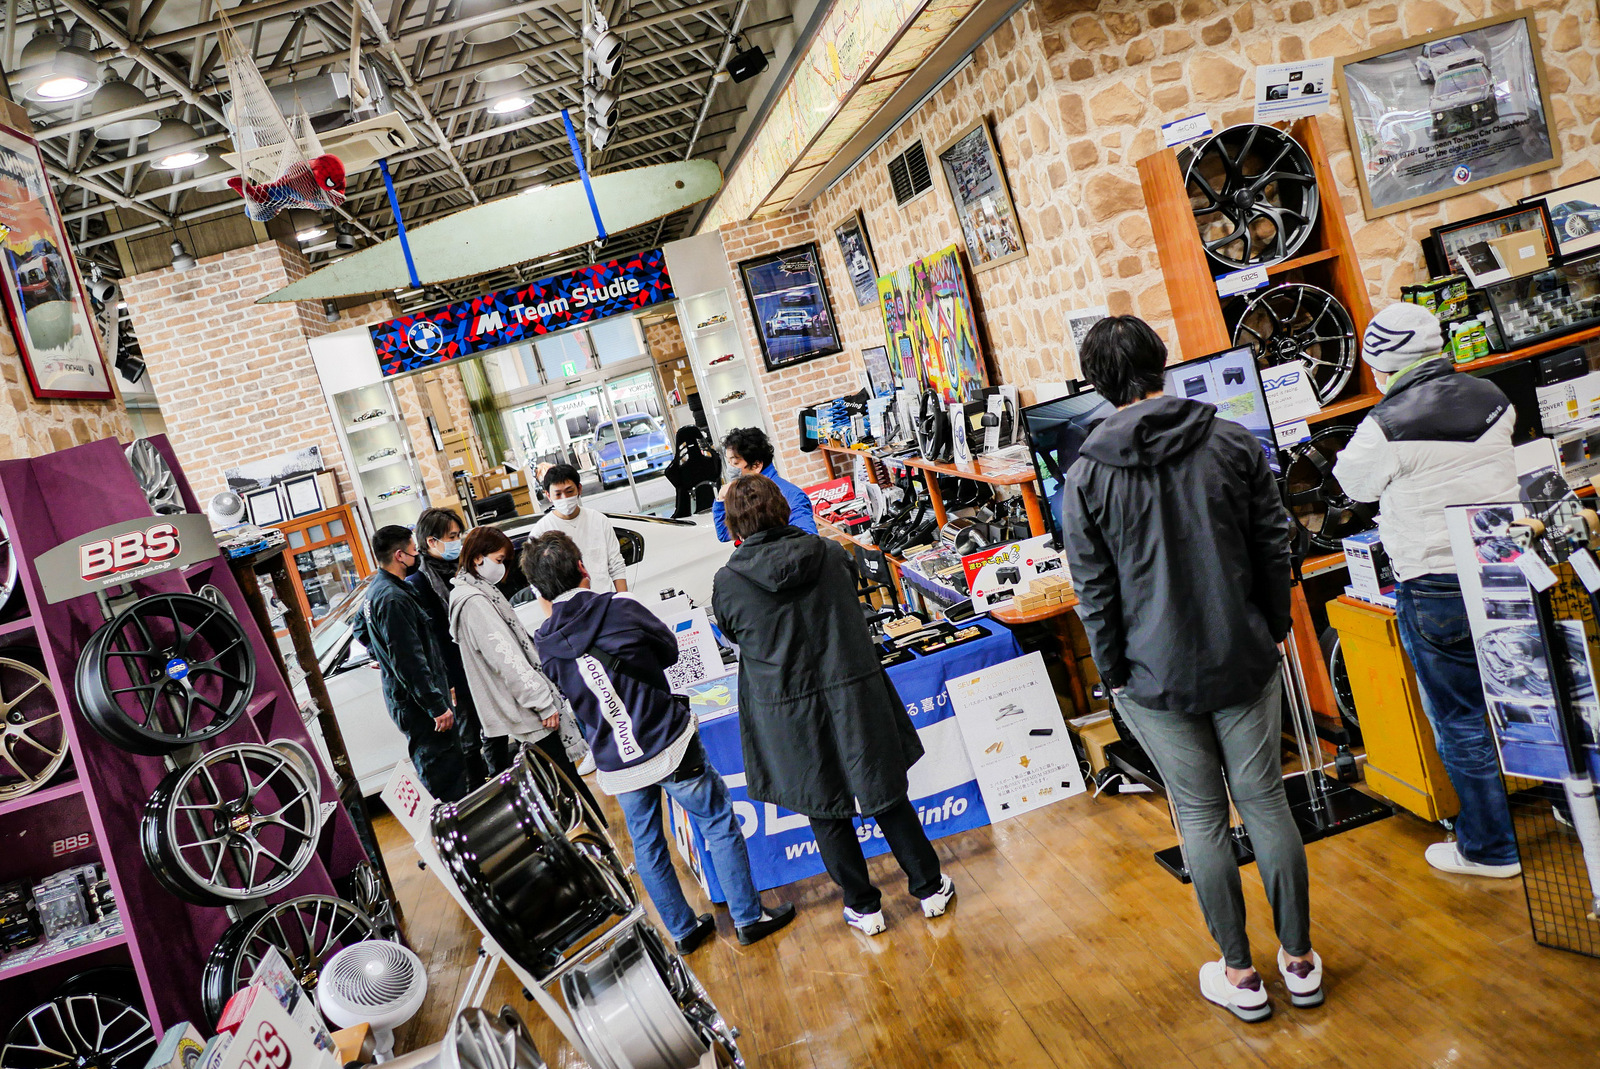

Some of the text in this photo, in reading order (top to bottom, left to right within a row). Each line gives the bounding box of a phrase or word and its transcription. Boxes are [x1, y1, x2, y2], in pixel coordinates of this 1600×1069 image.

[1418, 140, 1452, 154] European
[1452, 134, 1479, 145] Touring
[1479, 129, 1492, 137] Car
[1436, 149, 1448, 157] the
[1448, 143, 1470, 155] eighth
[509, 297, 570, 323] Team
[572, 276, 640, 307] Studie
[1263, 371, 1300, 392] AYS
[1538, 401, 1564, 412] CONVERT
[808, 482, 849, 501] Eibach
[79, 523, 181, 582] BBS
[103, 561, 171, 585] www.bbs-japan.co.jp
[168, 663, 187, 675] BBS
[906, 690, 948, 717] る喜び
[616, 719, 636, 756] BMW
[53, 833, 90, 855] BBS
